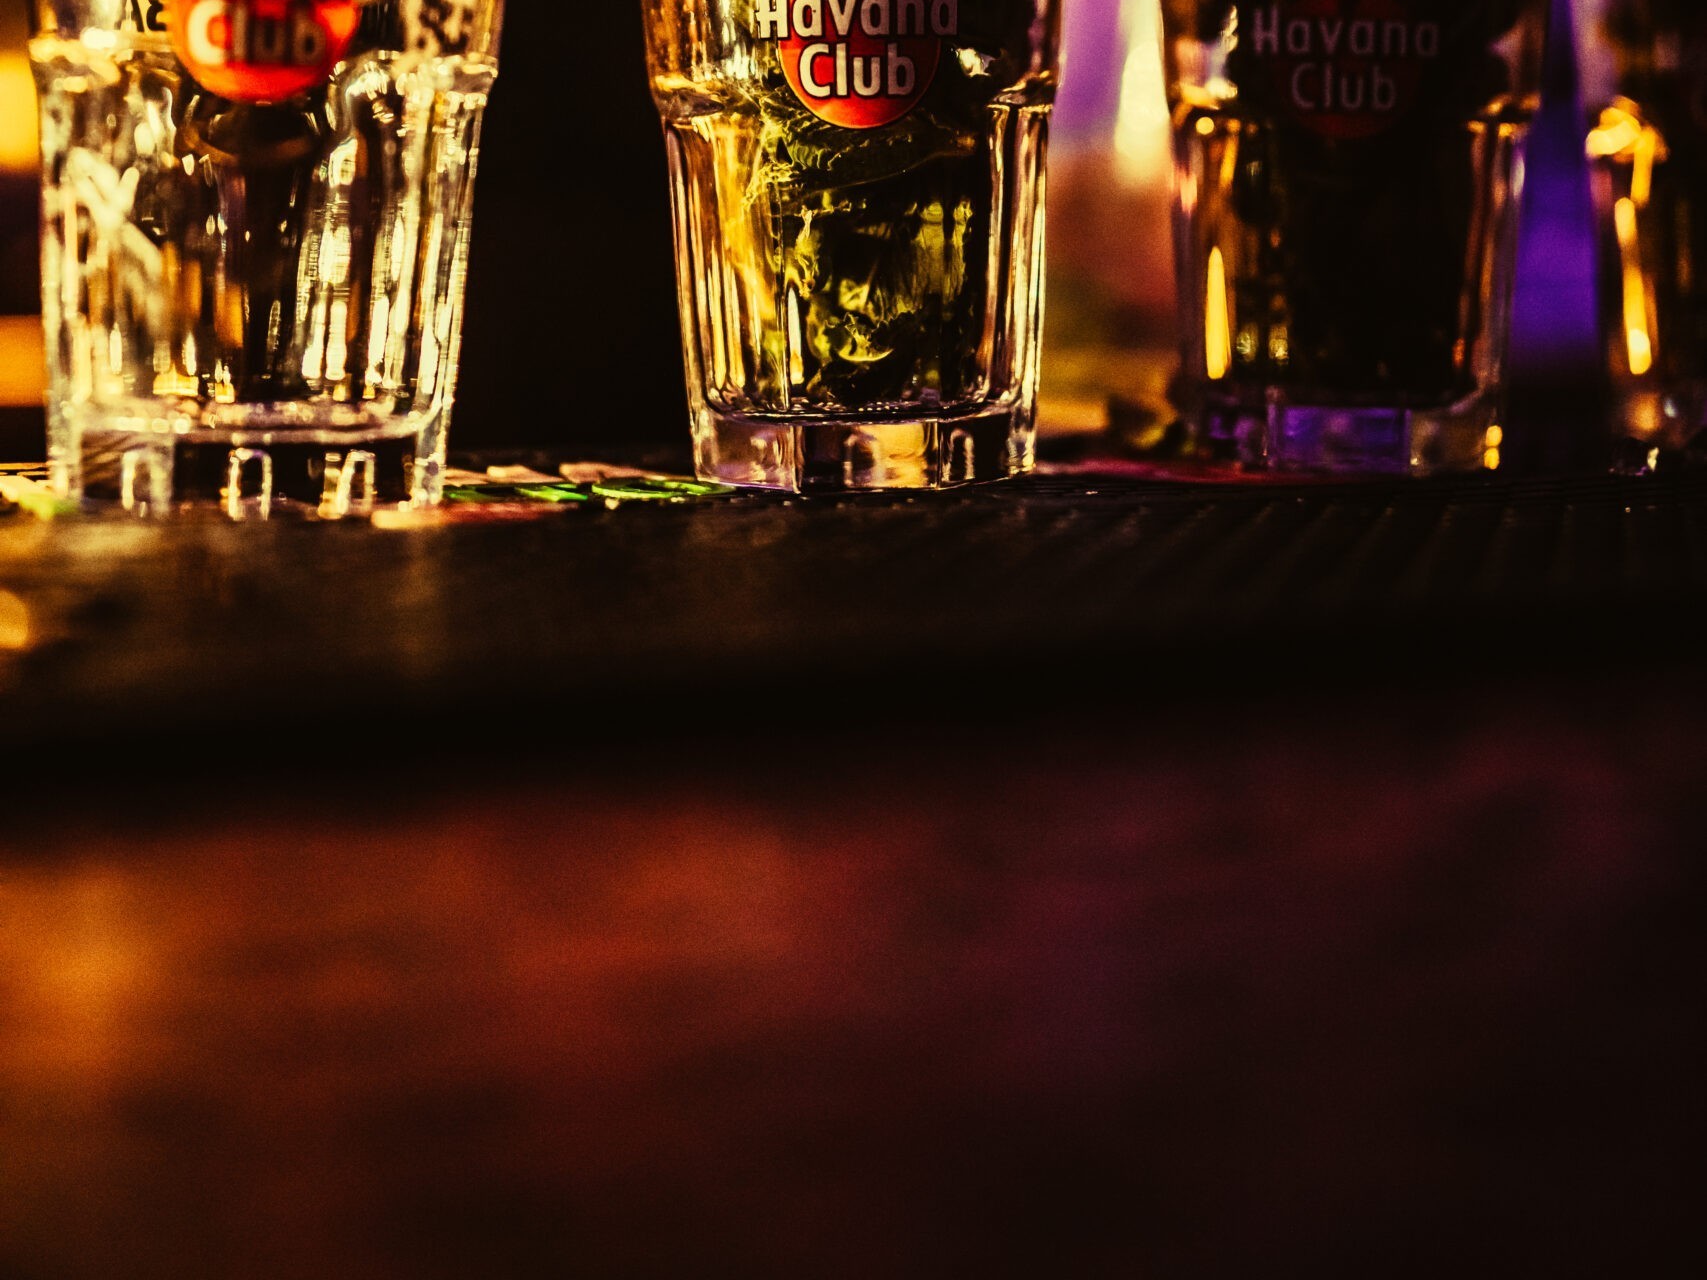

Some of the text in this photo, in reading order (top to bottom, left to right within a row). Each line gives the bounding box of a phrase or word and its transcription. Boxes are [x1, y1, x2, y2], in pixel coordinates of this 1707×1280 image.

[1253, 7, 1439, 56] Havana
[799, 42, 916, 98] Club
[1291, 62, 1396, 110] Club
